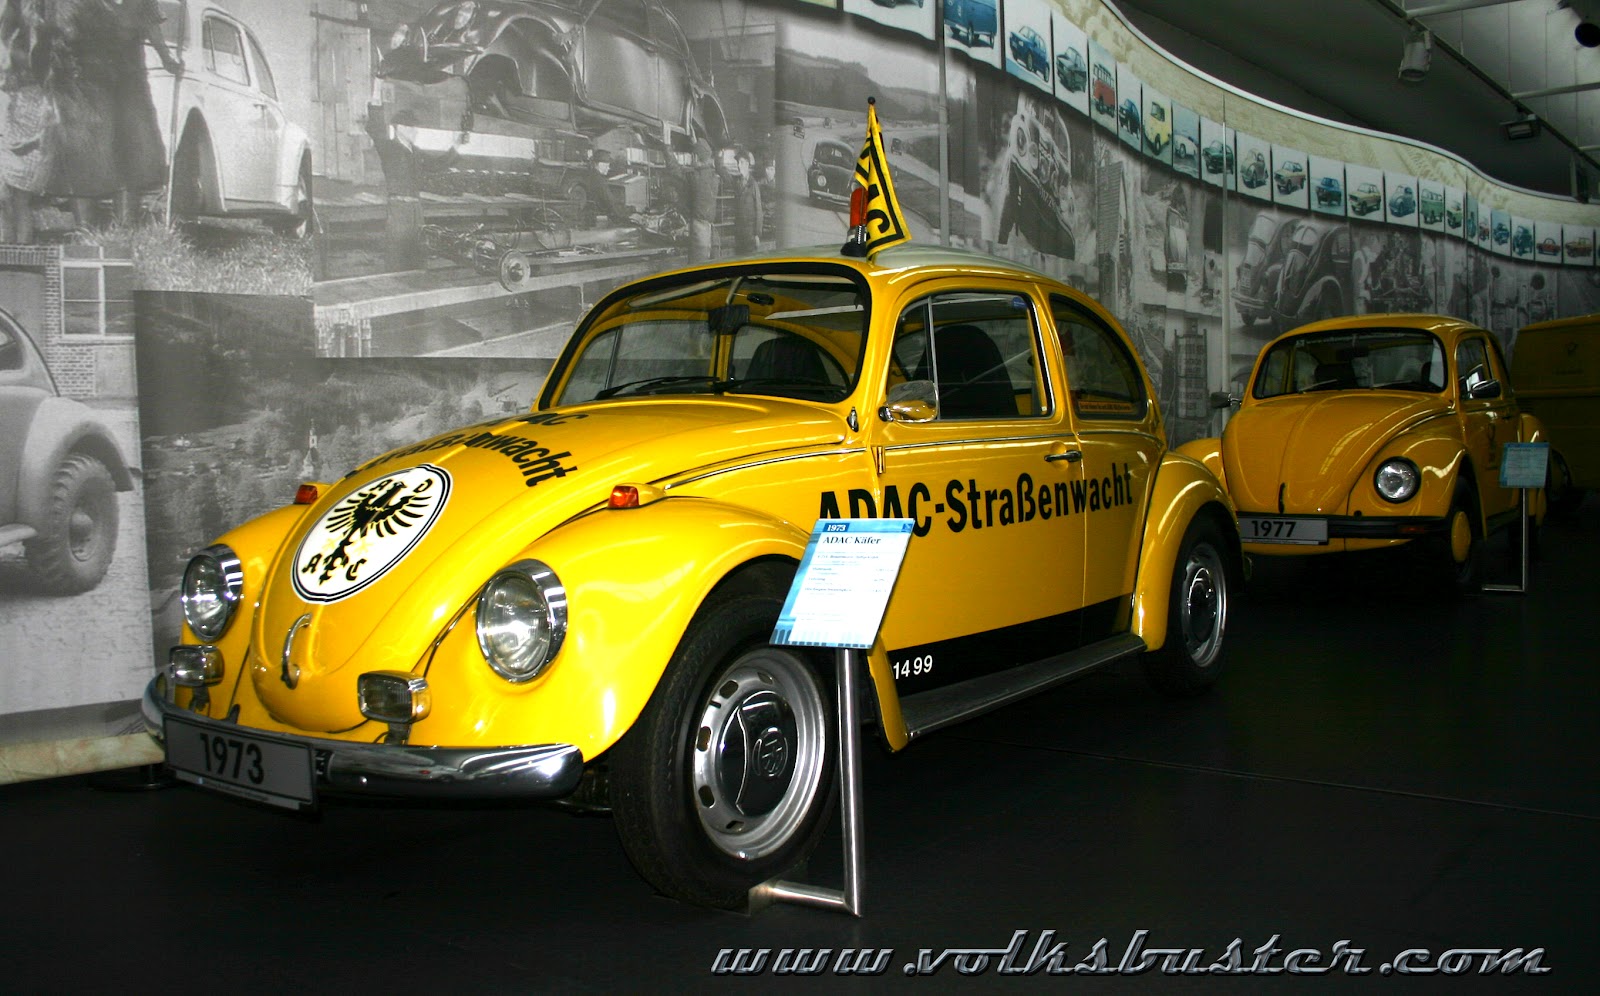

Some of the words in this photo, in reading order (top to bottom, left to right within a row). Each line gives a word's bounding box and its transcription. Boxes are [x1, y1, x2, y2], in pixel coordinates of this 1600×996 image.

[826, 524, 847, 532] 1973
[1251, 520, 1297, 538] 1977
[822, 536, 852, 545] ADAC
[854, 535, 882, 545] Käfer
[199, 733, 264, 785] 1973
